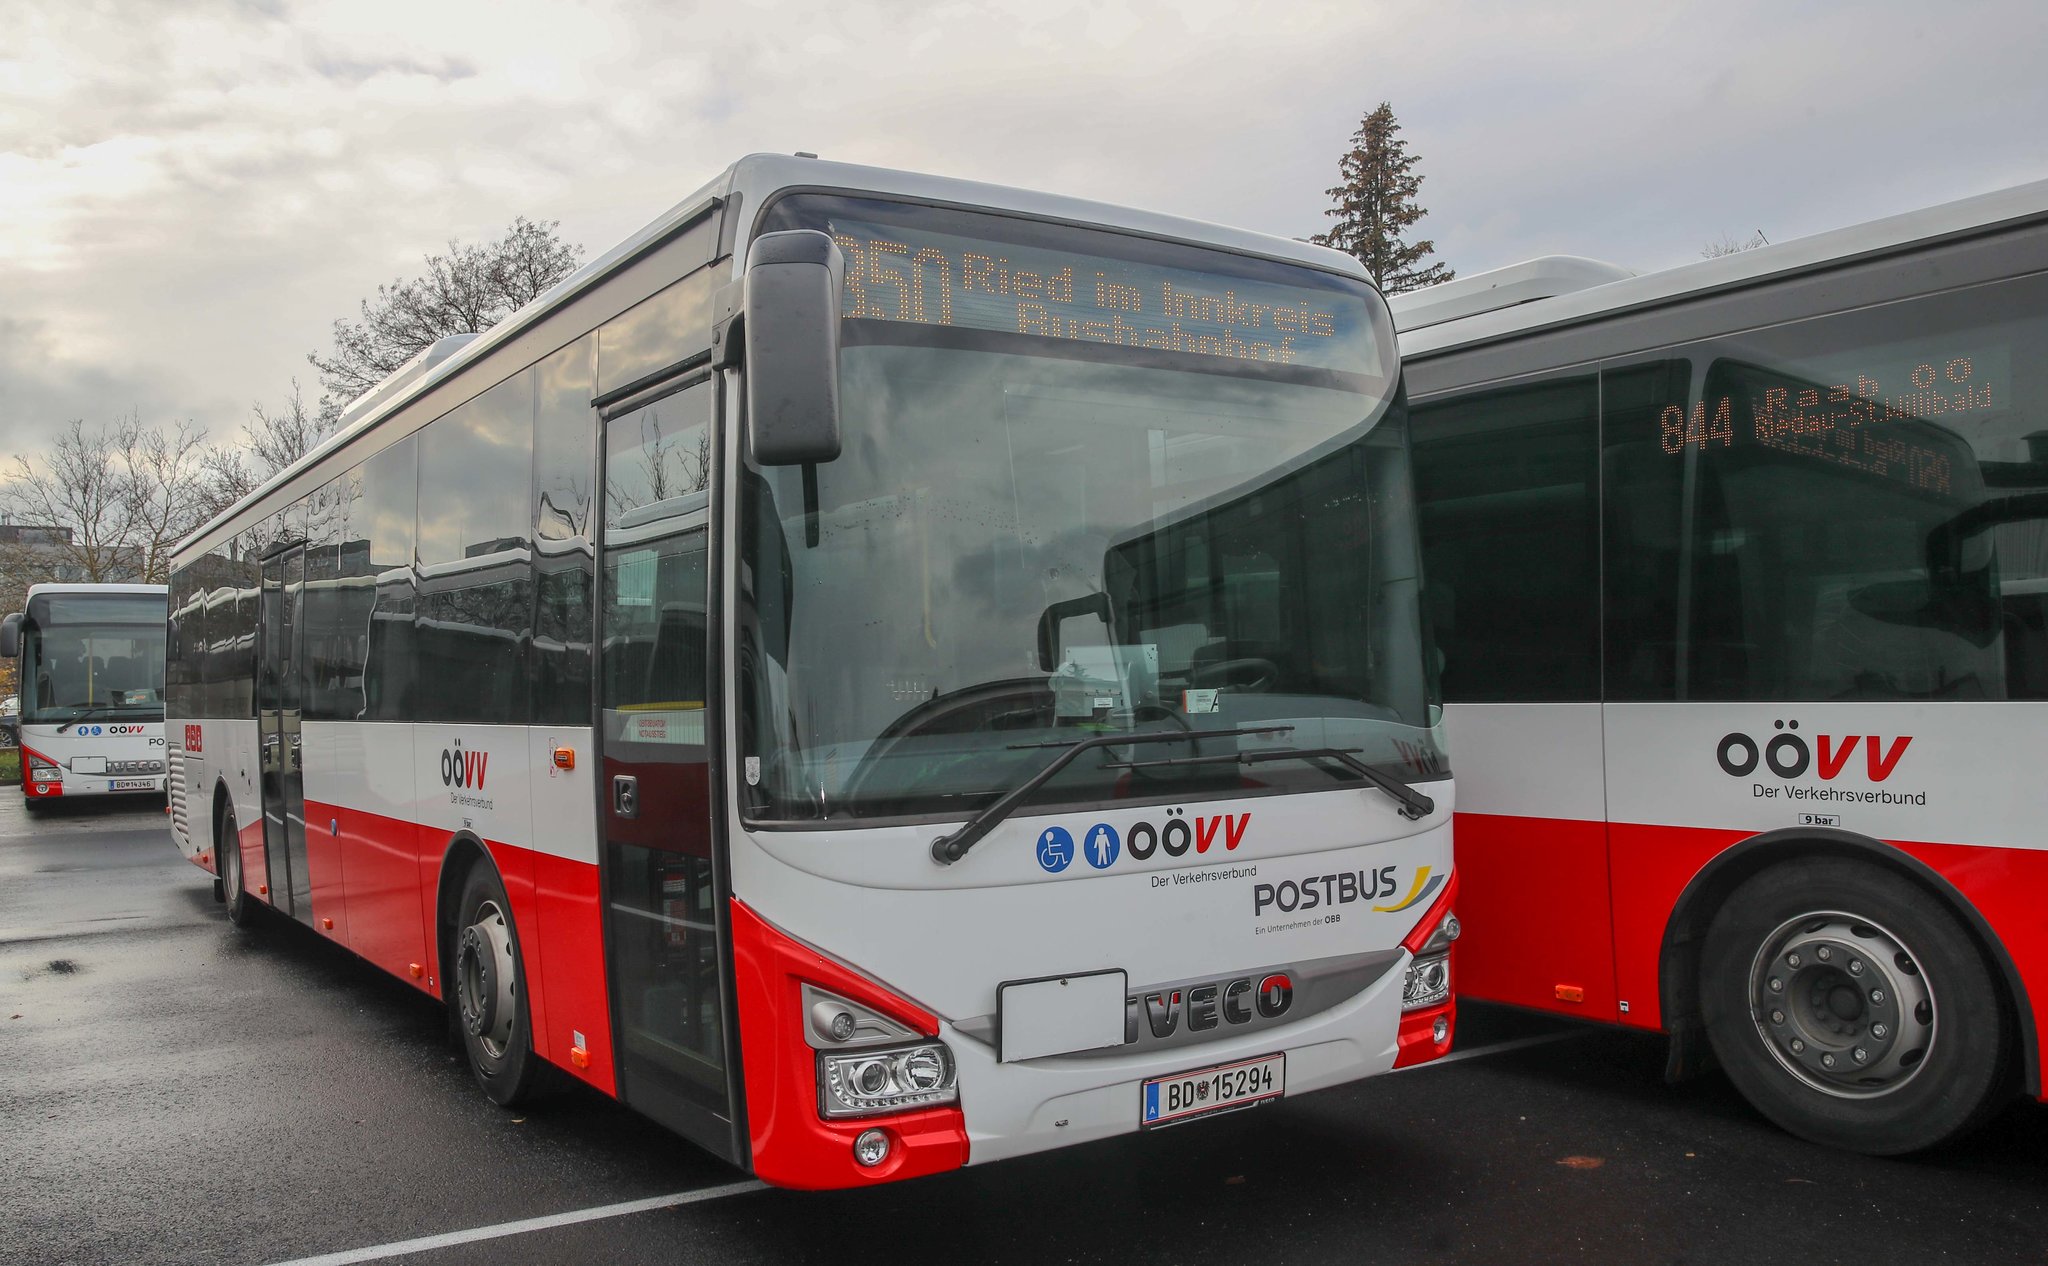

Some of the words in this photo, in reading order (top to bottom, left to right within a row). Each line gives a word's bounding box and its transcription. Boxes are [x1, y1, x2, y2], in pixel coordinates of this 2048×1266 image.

[963, 252, 1072, 303] Ried
[1097, 271, 1142, 313] im
[1163, 282, 1336, 337] Innkreis
[1661, 396, 1733, 454] 844
[110, 723, 144, 734] OÖVV
[1716, 719, 1914, 782] OÖVV
[441, 738, 488, 790] OÖVV
[1753, 783, 1780, 798] Der
[1784, 785, 1926, 806] Verkehrsverbund
[1805, 815, 1812, 825] 9
[1814, 815, 1833, 826] bar
[1127, 807, 1252, 861] OÖVV
[1151, 875, 1170, 888] Der
[1172, 865, 1257, 886] Verkehrsverbund
[1253, 865, 1397, 917] POSTBUS
[1255, 926, 1266, 935] Ein
[1267, 920, 1311, 934] Unternehmen
[1312, 917, 1323, 927] der
[1127, 973, 1294, 1045] IVECO
[1149, 1105, 1156, 1115] A
[1168, 1081, 1195, 1112] BD
[1211, 1064, 1273, 1102] 15294
